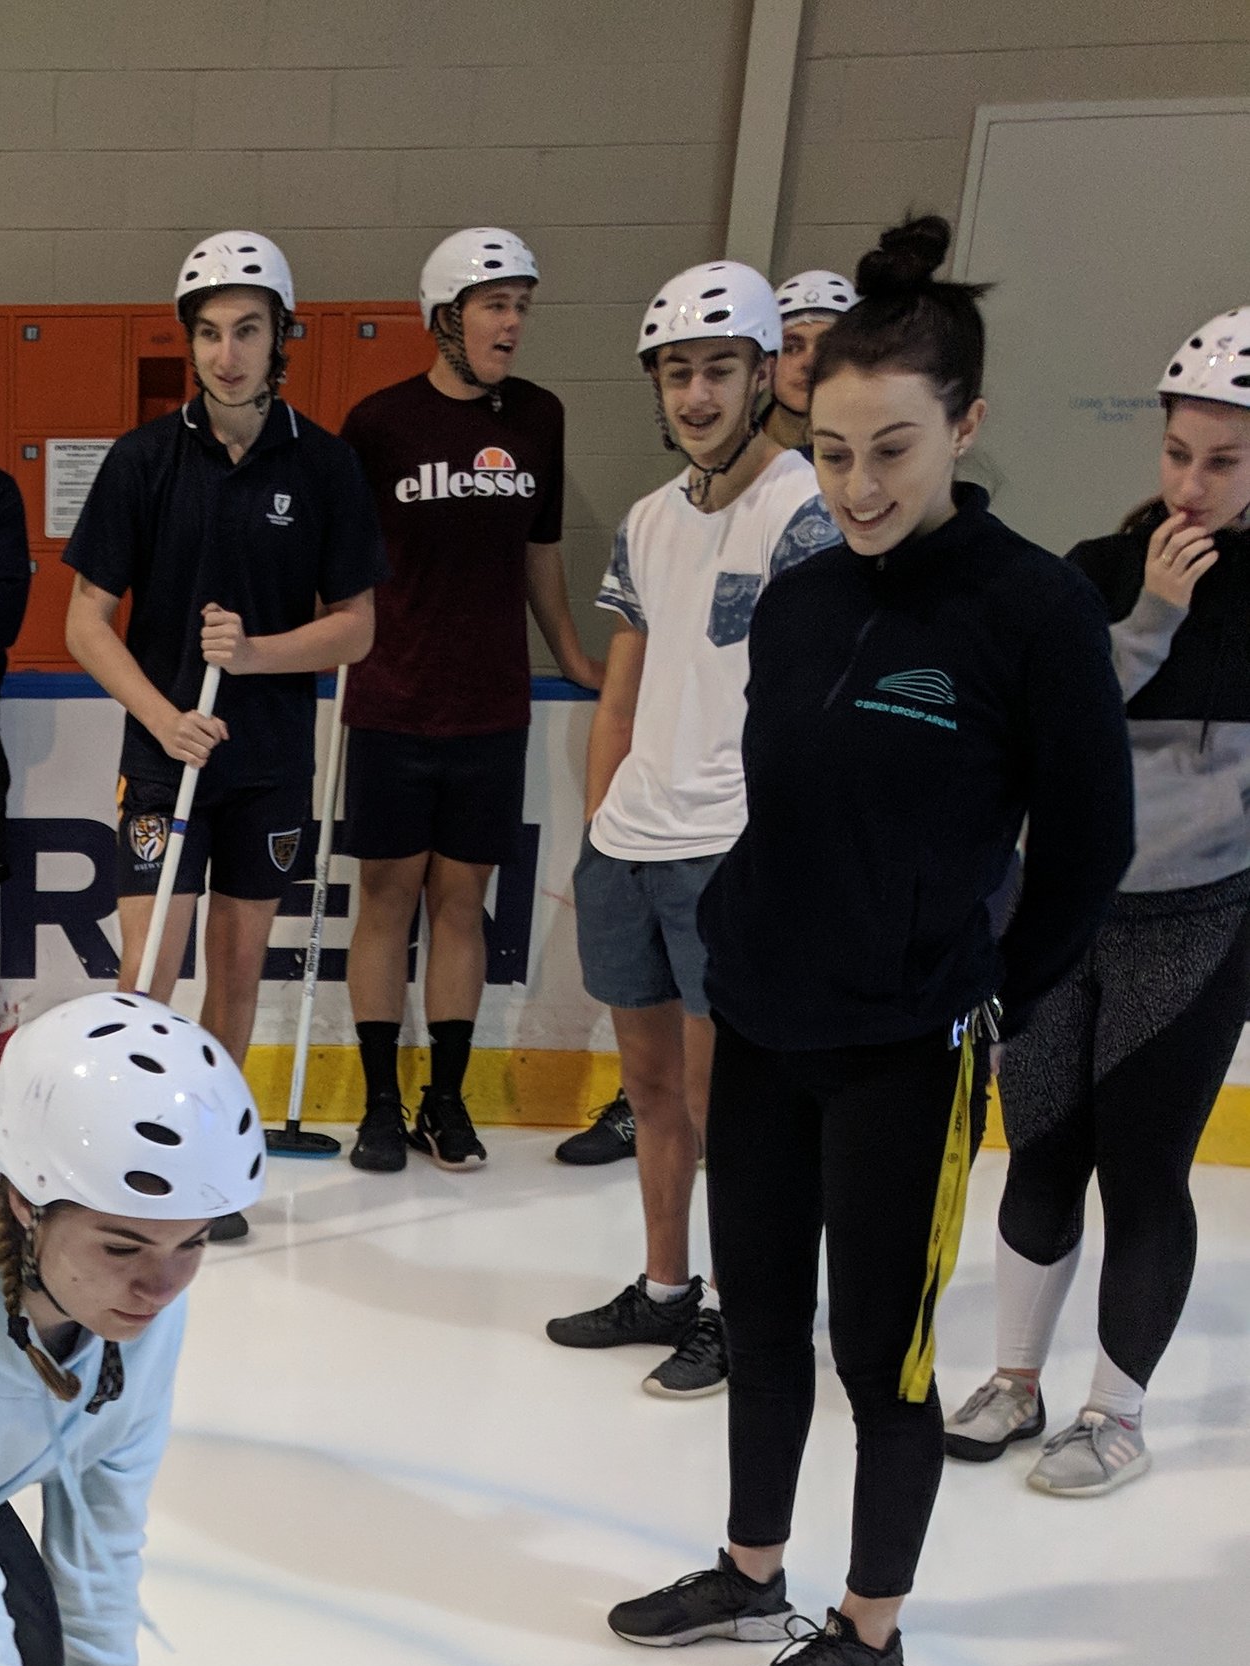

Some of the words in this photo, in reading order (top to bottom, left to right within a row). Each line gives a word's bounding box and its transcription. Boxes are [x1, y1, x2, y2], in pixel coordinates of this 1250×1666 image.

[395, 461, 536, 503] ellesse
[890, 705, 926, 720] GROUP
[924, 715, 958, 731] ARENA
